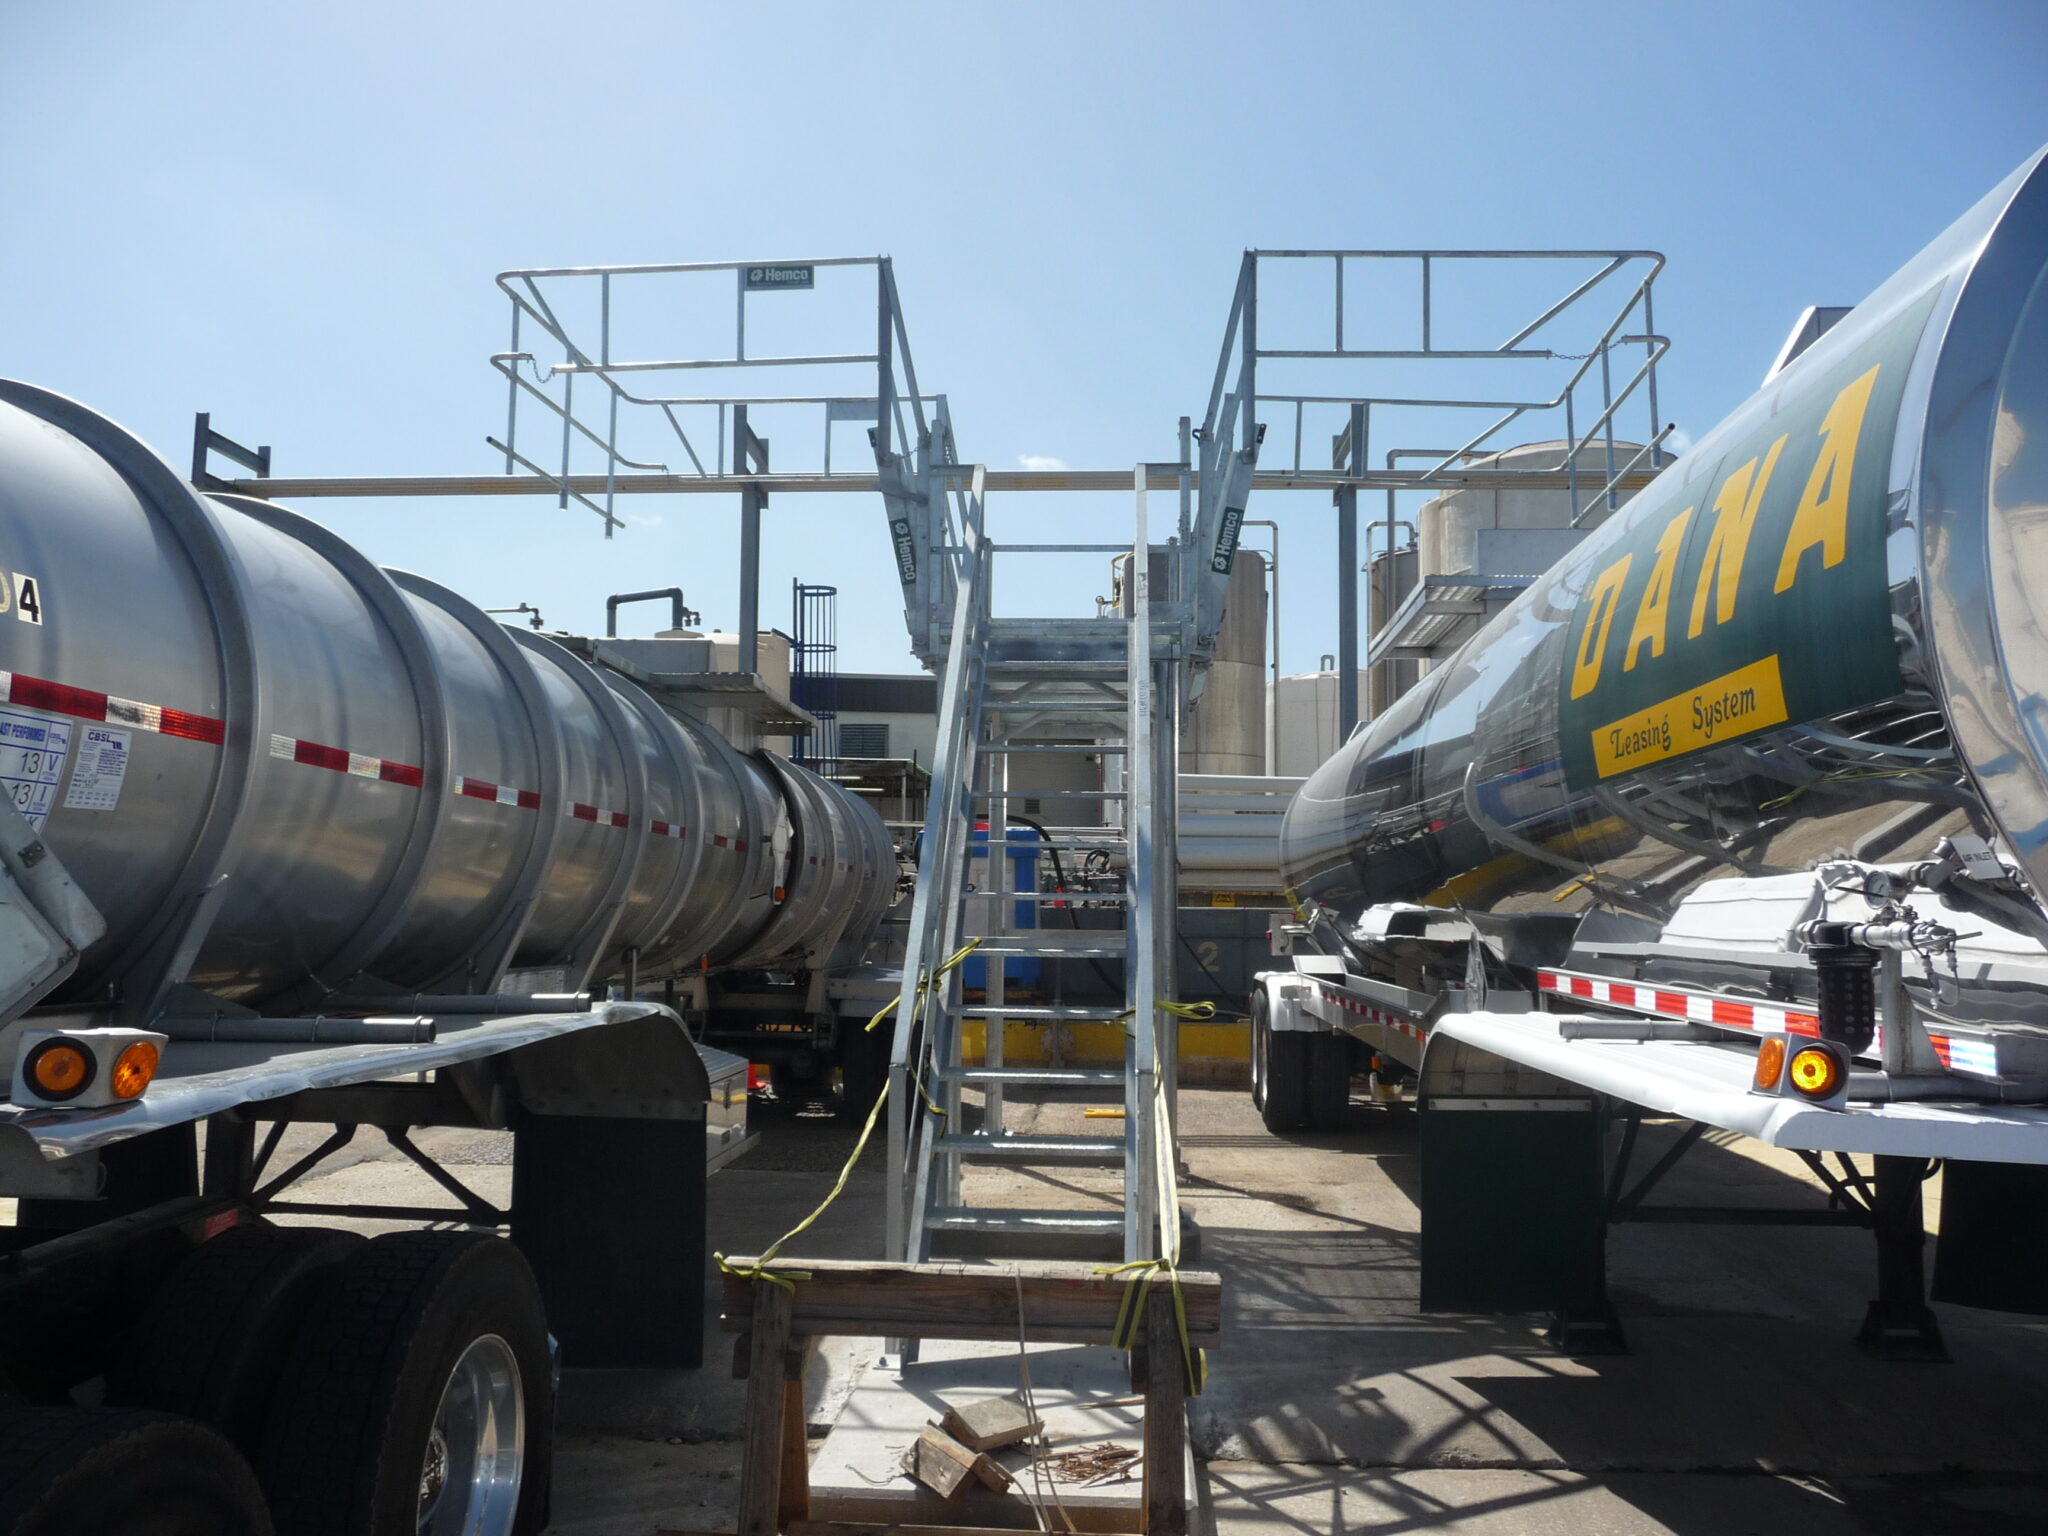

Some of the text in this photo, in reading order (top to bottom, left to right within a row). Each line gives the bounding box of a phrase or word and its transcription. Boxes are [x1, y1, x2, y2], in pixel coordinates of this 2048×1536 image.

[765, 267, 809, 281] Hemco
[1216, 511, 1238, 556] Hemco
[1571, 363, 1881, 701] DANA
[897, 536, 916, 581] Hemco
[1610, 687, 1756, 760] Leasing System
[87, 731, 111, 744] CBSL
[21, 751, 41, 774] 13
[48, 754, 59, 771] V
[11, 783, 31, 805] 13
[1198, 941, 1220, 973] 2
